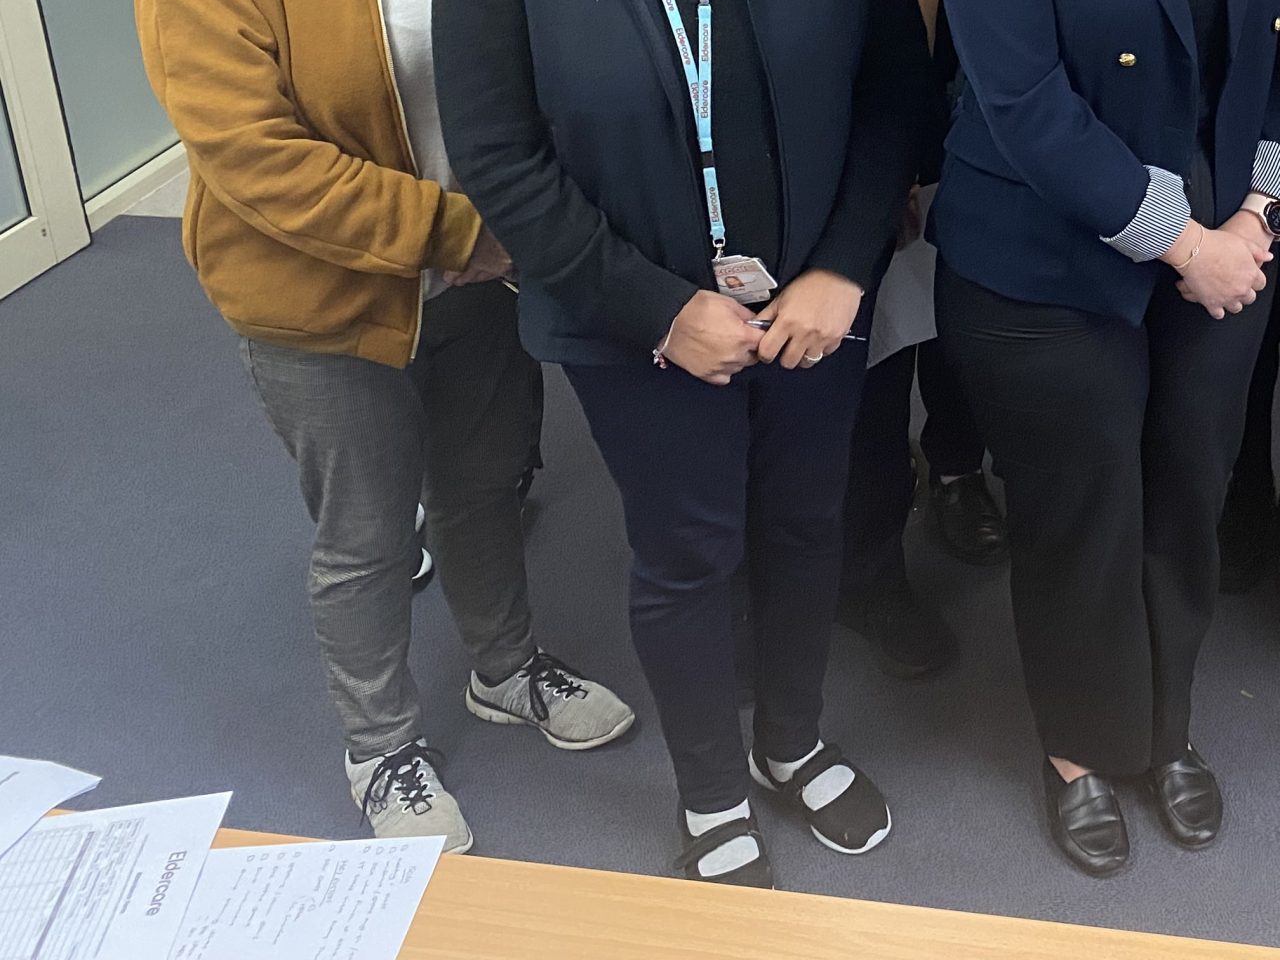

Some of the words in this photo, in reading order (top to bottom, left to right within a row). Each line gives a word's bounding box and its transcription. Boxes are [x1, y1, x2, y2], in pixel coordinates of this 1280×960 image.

[676, 28, 690, 65] Eldercare
[701, 80, 709, 119] Eldercare
[709, 186, 720, 223] Eldercare
[145, 850, 188, 916] Eldercare
